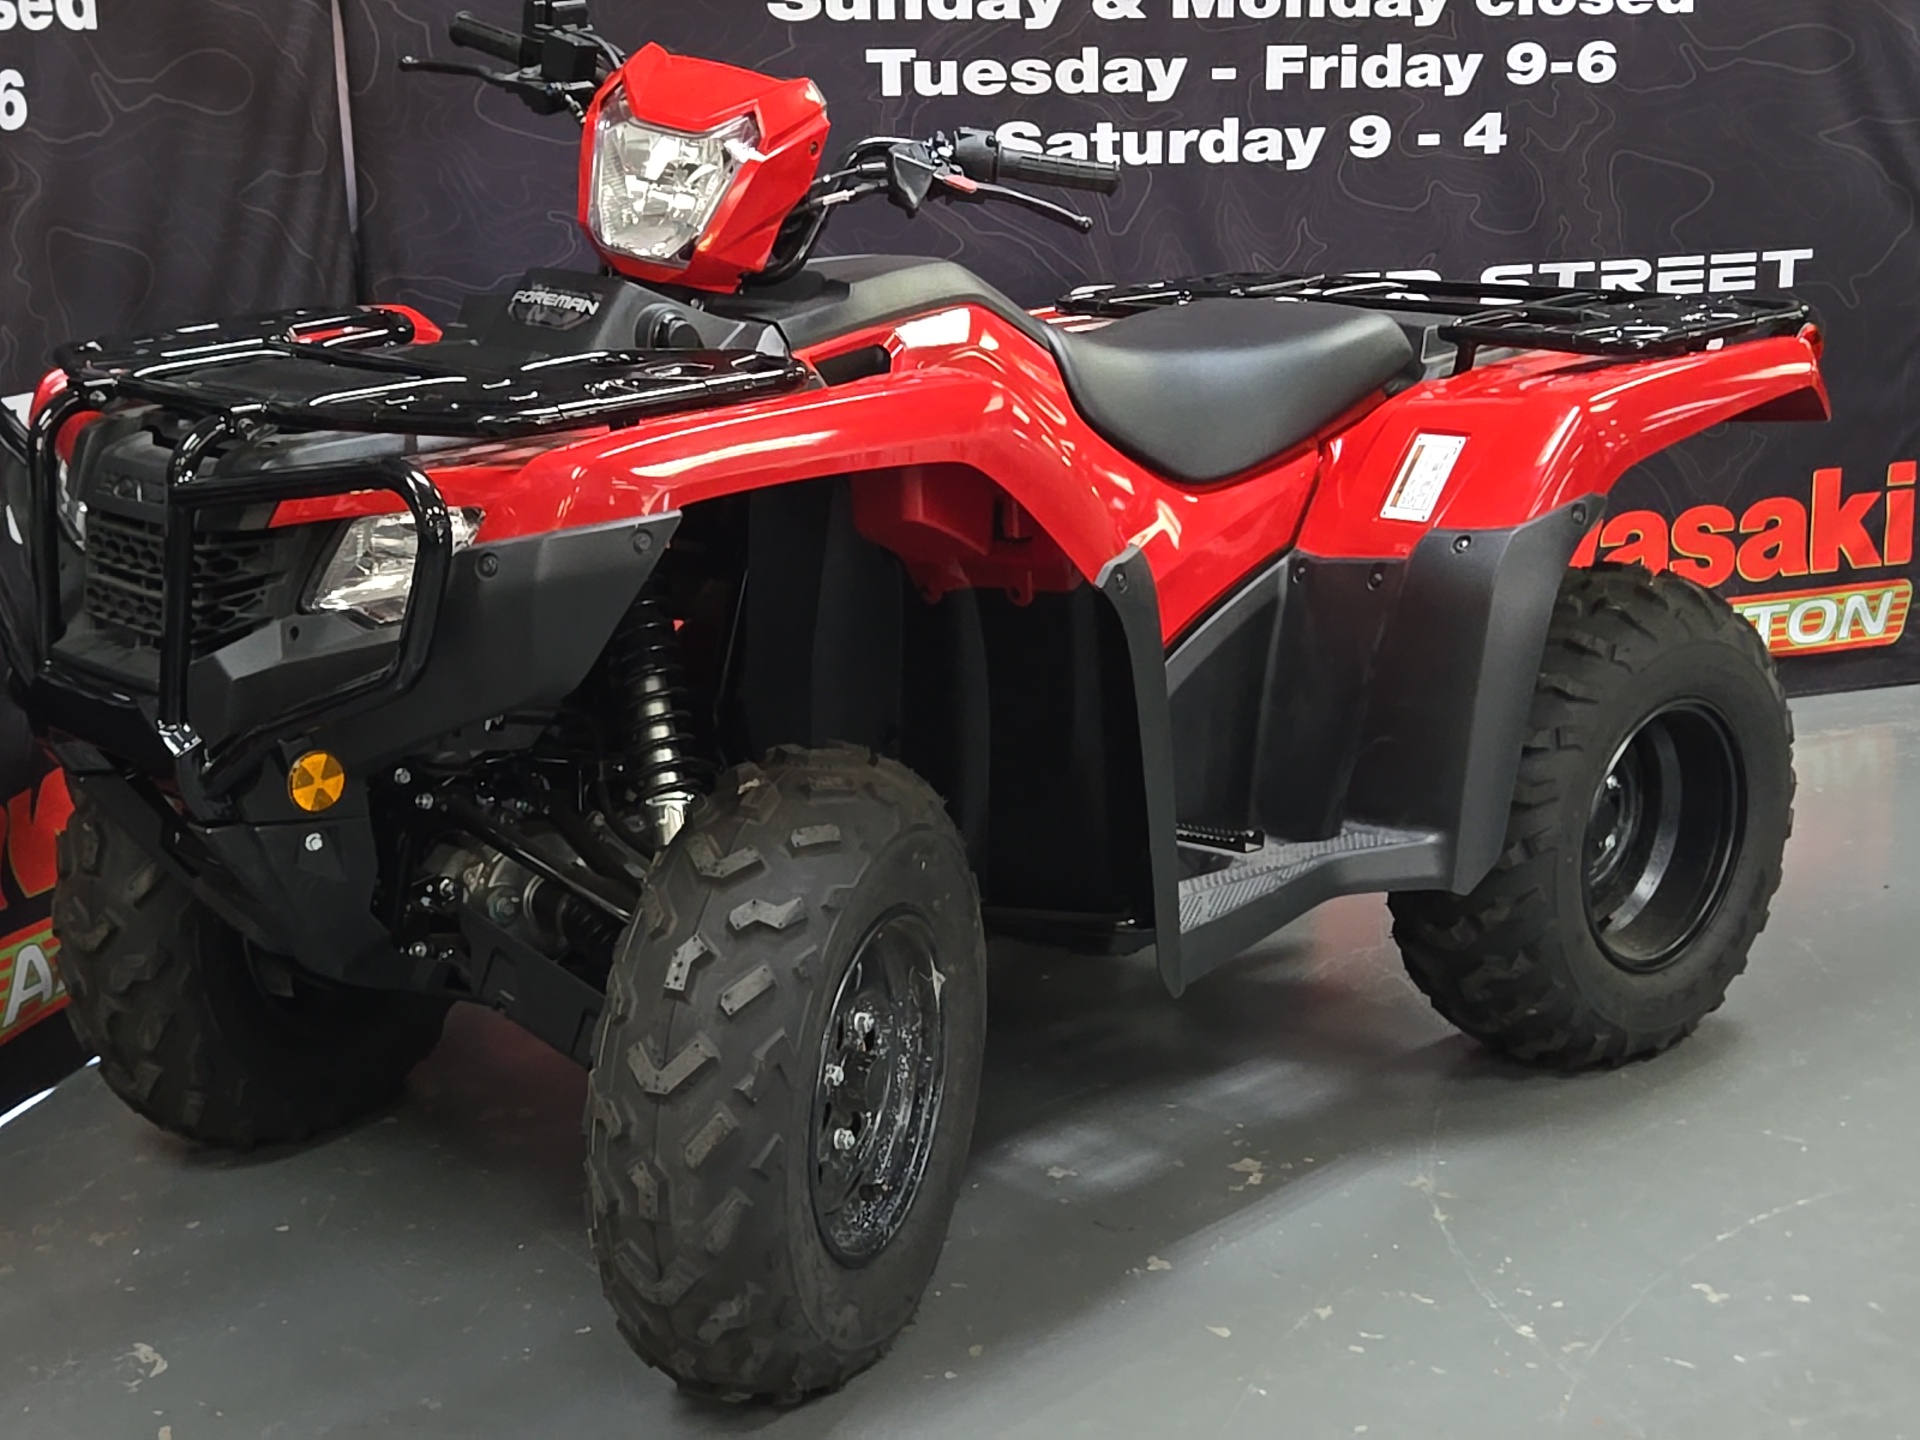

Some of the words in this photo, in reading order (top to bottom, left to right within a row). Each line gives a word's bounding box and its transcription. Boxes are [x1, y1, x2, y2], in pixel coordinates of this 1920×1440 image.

[865, 47, 1188, 102] Tuesday
[1265, 43, 1484, 96] Friday
[1506, 40, 1617, 85] 9-6
[995, 117, 1326, 170] Saturday
[1349, 115, 1392, 158] 9
[1463, 113, 1508, 154] 4
[511, 290, 599, 315] FOREMAN
[1480, 248, 1814, 305] STREET
